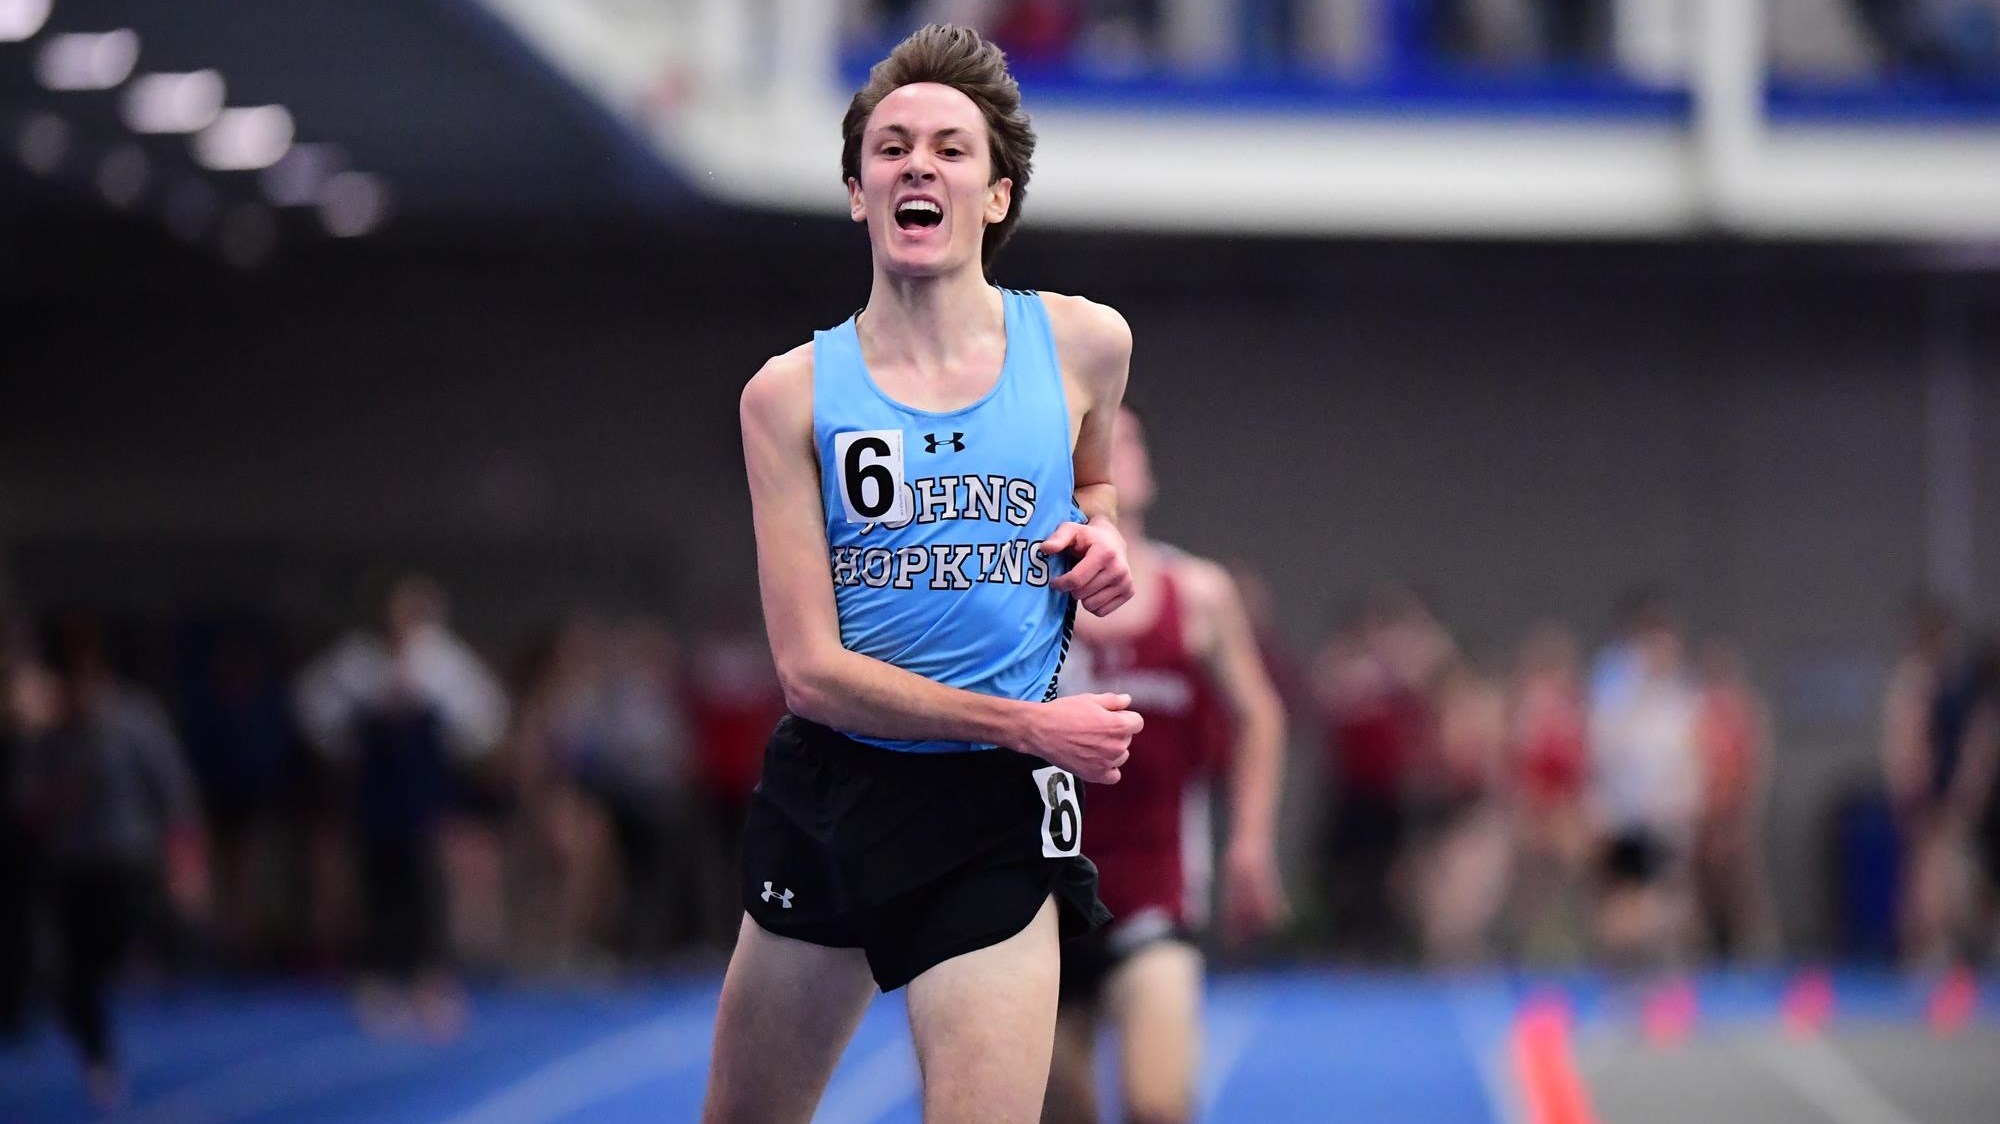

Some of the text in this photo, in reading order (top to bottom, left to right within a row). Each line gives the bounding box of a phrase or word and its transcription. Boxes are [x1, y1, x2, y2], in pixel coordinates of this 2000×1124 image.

[845, 437, 894, 518] 6
[833, 539, 1050, 590] HOPKINS
[1047, 771, 1077, 852] 6
